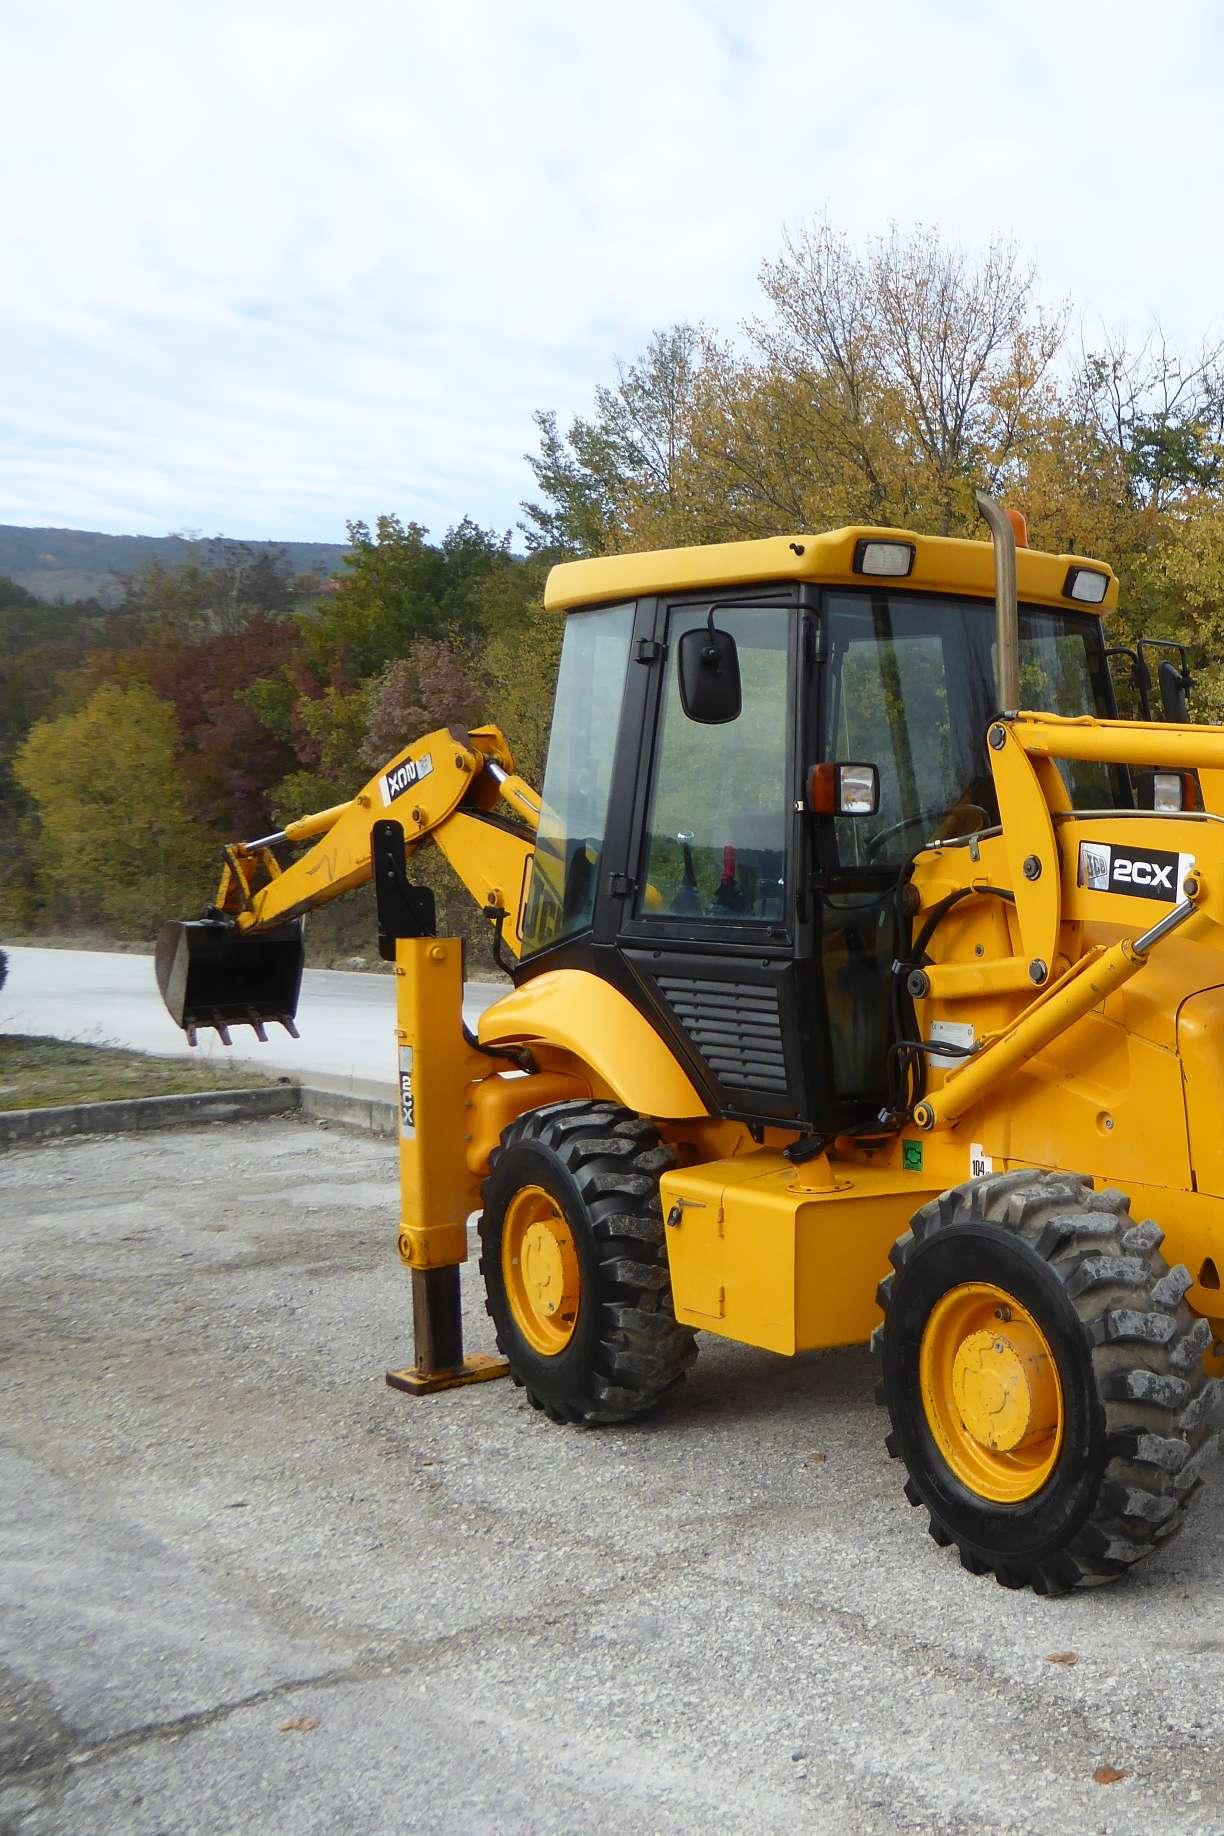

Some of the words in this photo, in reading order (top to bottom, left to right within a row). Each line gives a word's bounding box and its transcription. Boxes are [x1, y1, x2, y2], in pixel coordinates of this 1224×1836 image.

[1113, 858, 1173, 889] 2CX
[402, 1075, 414, 1123] 2CX
[972, 1160, 985, 1177] 104
